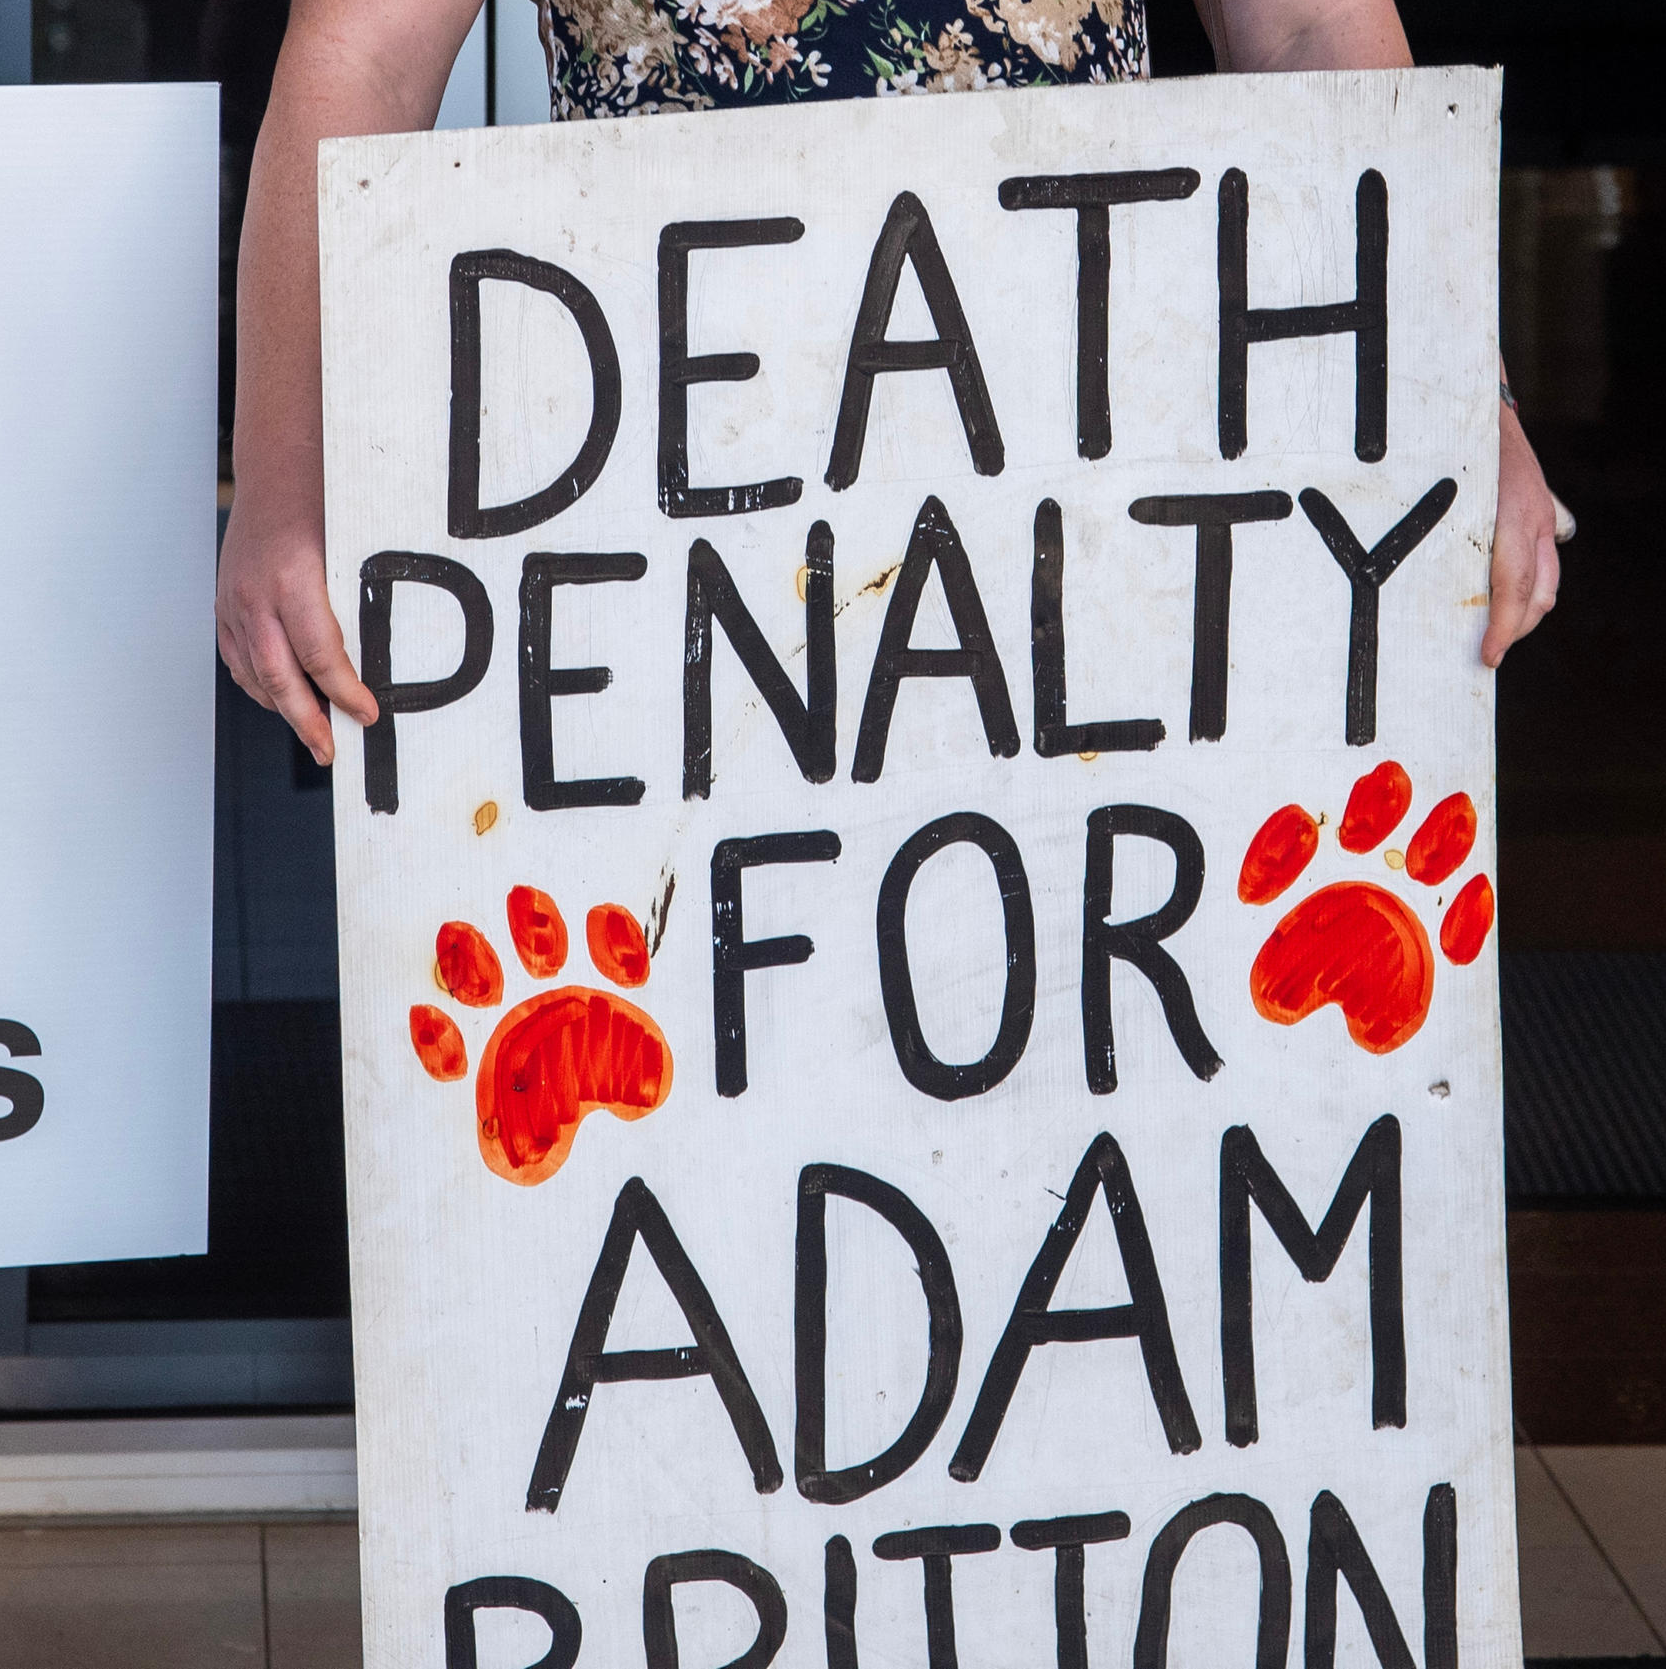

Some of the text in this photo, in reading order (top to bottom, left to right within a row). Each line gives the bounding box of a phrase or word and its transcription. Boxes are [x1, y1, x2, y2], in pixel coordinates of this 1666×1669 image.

[448, 167, 1387, 539] DEATH
[360, 476, 1458, 814] PENALTY
[710, 803, 1226, 1101] FOR
[525, 1113, 1408, 1514] ADAM
